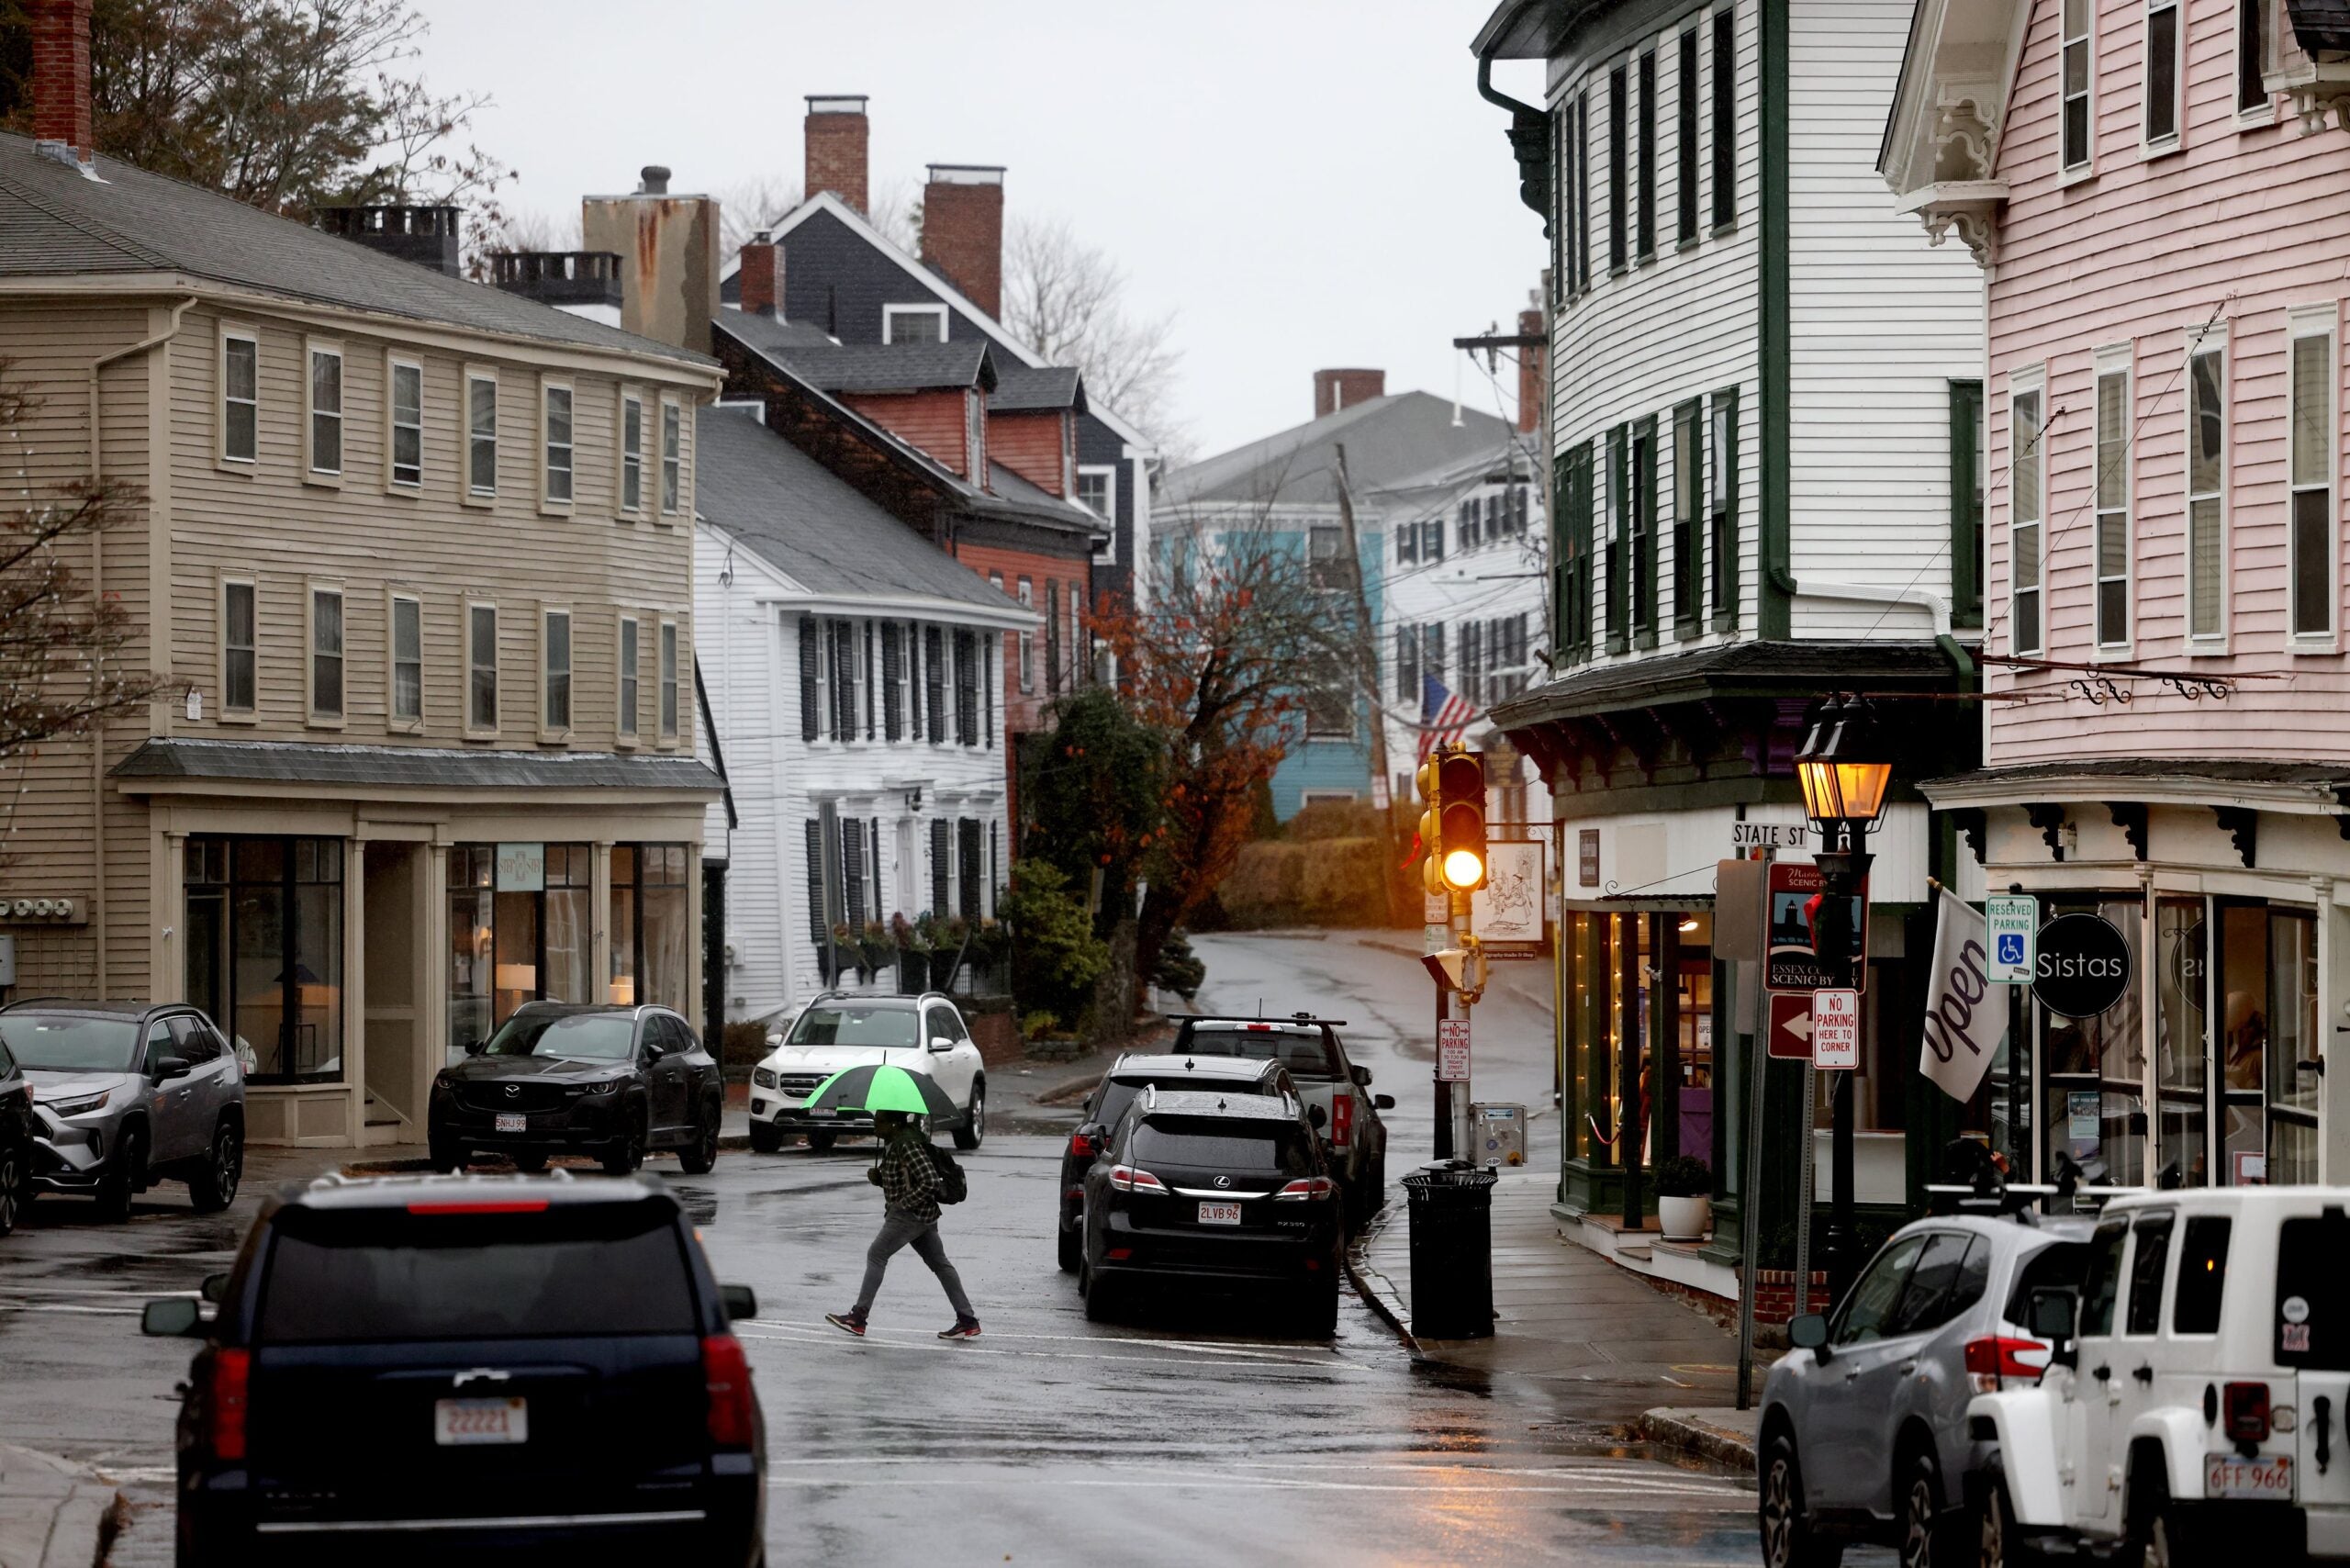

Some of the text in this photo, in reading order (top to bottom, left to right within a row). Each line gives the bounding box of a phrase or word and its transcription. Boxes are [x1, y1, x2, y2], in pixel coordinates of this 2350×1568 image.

[1734, 824, 1806, 845] STATE ST
[1788, 879, 1818, 887] SCENIC
[1989, 904, 2031, 915] RESERVED
[1994, 919, 2030, 931] PARKING
[1772, 964, 1805, 975] ESSEX
[2037, 952, 2122, 978] Sistas
[1772, 975, 1817, 985] SCENIC
[1829, 997, 1842, 1011] NO
[1924, 939, 1988, 1063] Open
[1817, 1014, 1854, 1027] PARKING
[1449, 1025, 1460, 1037] NO
[1818, 1029, 1852, 1039] HERE TO
[1441, 1037, 1469, 1049] PARKING
[1820, 1042, 1851, 1052] CORNER
[496, 1119, 526, 1128] 5NHJ 99
[1201, 1207, 1238, 1220] 2LVB 96
[2210, 1465, 2288, 1490] 6FF 966
